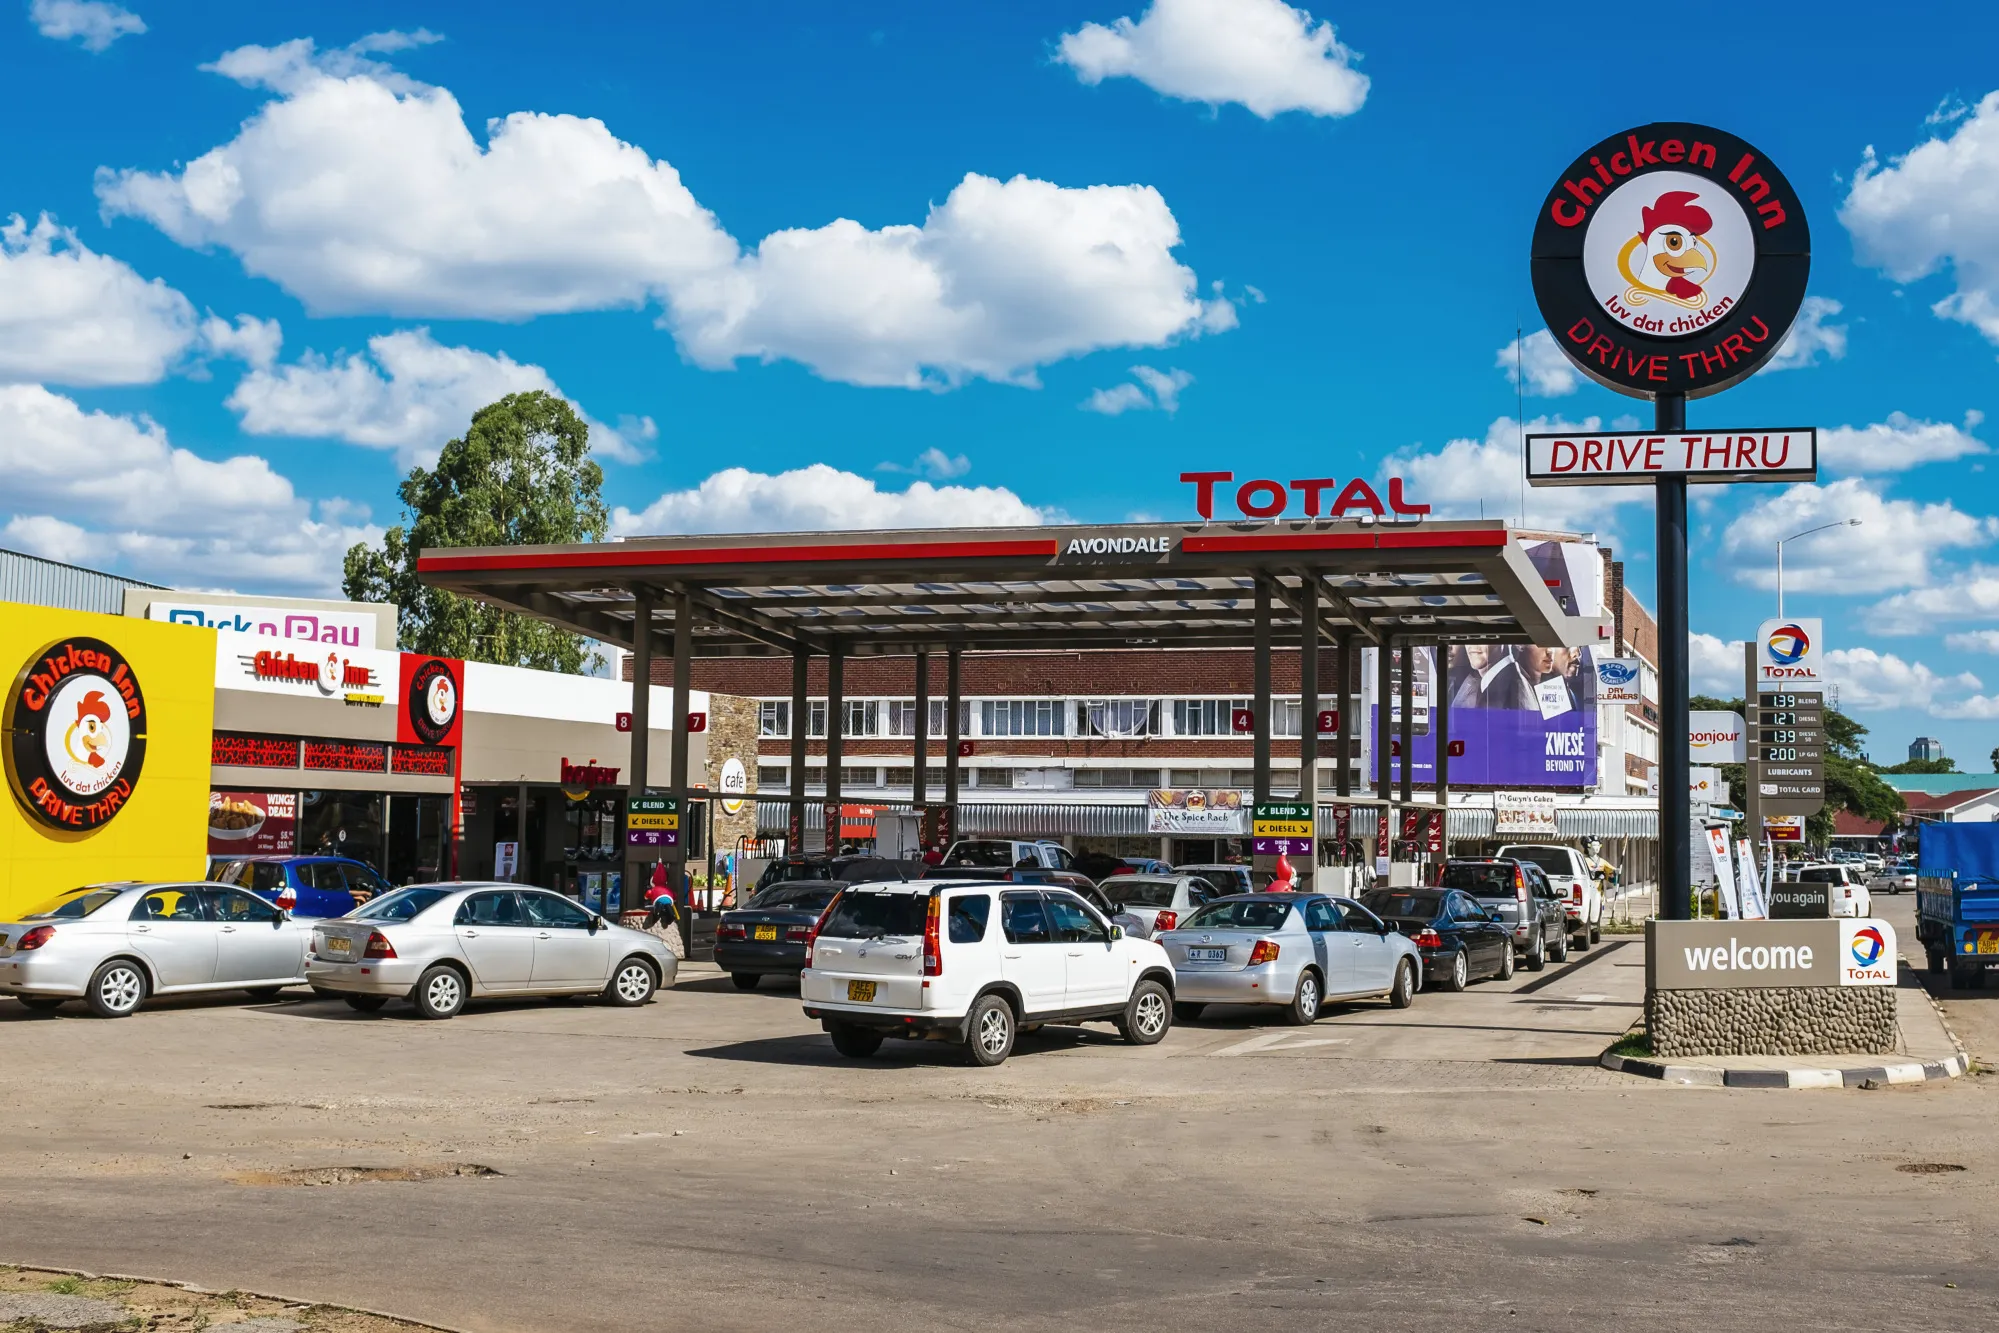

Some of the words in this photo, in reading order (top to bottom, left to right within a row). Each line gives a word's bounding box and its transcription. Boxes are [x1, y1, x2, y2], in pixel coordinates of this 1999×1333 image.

[1551, 135, 1717, 228] Chicken
[1727, 152, 1787, 229] Inn
[1604, 295, 1631, 320] luv
[1633, 316, 1664, 332] dat
[1669, 295, 1734, 332] chicken
[1567, 317, 1669, 382] DRIVE
[1679, 315, 1769, 379] THRU
[1550, 438, 1666, 472] DRIVE
[1680, 436, 1790, 469] THRU
[1180, 471, 1431, 520] TOTAL
[1067, 537, 1170, 555] AVONDALE
[253, 650, 320, 681] Chicken
[1762, 666, 1817, 678] TOTAL
[23, 643, 112, 711] Chicken
[110, 663, 141, 720] Inn
[1773, 695, 1795, 708] 1.39
[620, 716, 628, 728] 8
[692, 716, 700, 728] 7
[1238, 716, 1248, 727] 4
[1324, 715, 1333, 727] 3
[1774, 712, 1796, 725] 1.27
[1545, 727, 1585, 756] KWESÉ
[1774, 730, 1796, 743] 1.39
[963, 744, 970, 754] 5
[1454, 744, 1460, 754] 1
[1769, 748, 1796, 761] 2.00
[1545, 760, 1574, 772] BEYOND
[1576, 760, 1585, 772] TV
[1767, 768, 1813, 776] LUBRICANTS
[60, 769, 74, 788] luv
[75, 781, 91, 793] dat
[92, 761, 122, 792] chicken
[725, 770, 744, 789] café
[29, 776, 84, 826] DRIVE
[85, 777, 132, 824] THRU
[267, 793, 296, 806] WINGZ
[642, 801, 665, 809] BLEND
[268, 806, 294, 818] DEALZ
[1163, 811, 1180, 822] The
[1181, 811, 1206, 823] Spice
[1207, 812, 1229, 822] Rack
[1270, 807, 1297, 815] BLEND
[641, 818, 665, 826] DIESEL
[1269, 825, 1297, 833] DIESEL
[648, 836, 657, 844] 50
[1770, 892, 1791, 906] you
[1792, 890, 1825, 907] again
[1207, 950, 1224, 959] 0362
[1684, 937, 1814, 971] welcome
[1846, 968, 1891, 980] TOTAL
[855, 981, 870, 991] AEE
[852, 990, 872, 1001] 3779
